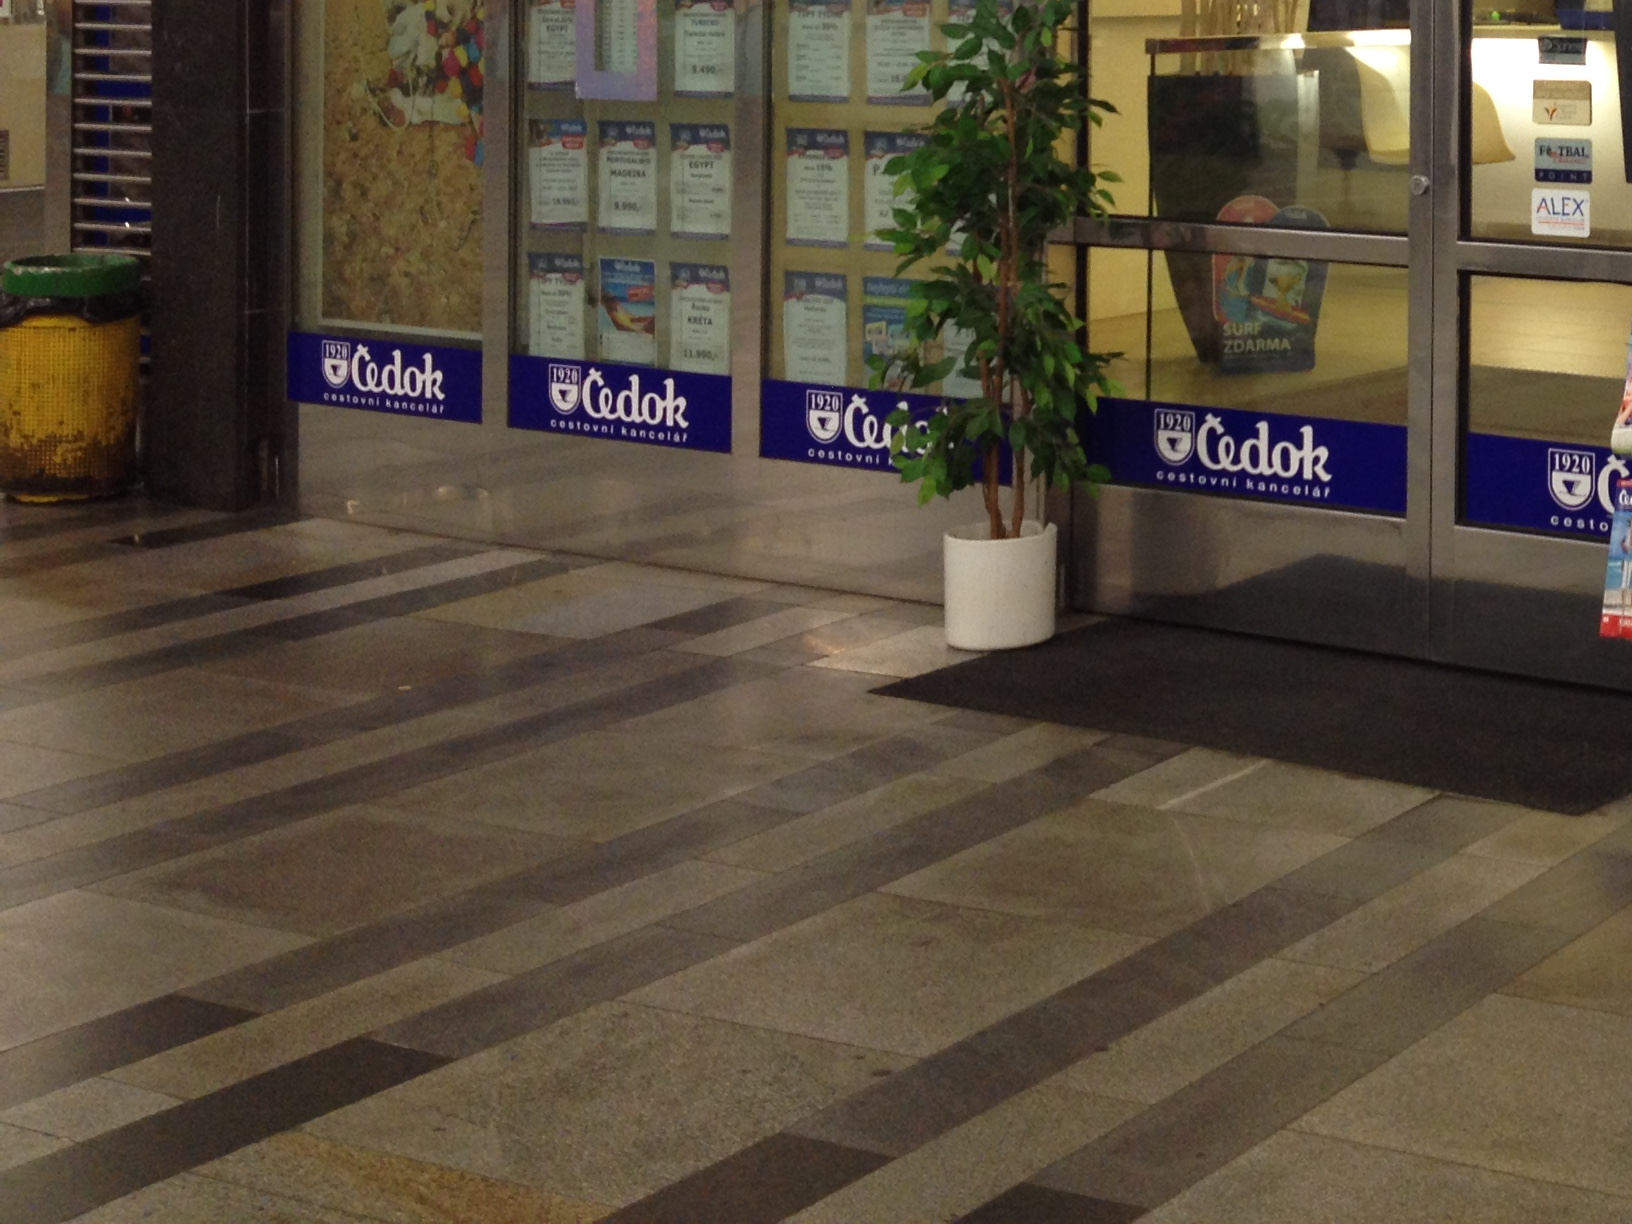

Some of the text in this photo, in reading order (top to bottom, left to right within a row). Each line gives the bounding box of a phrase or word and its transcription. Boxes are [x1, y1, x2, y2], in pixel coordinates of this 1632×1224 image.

[689, 161, 714, 169] EGYPT
[1536, 197, 1585, 217] ALEX
[1223, 323, 1262, 336] SURF
[1224, 338, 1292, 354] ZDARMA
[324, 343, 446, 401] 1920 Čedok
[323, 391, 446, 415] cestovní kancelář
[552, 366, 690, 429] 1920 Čedok
[810, 393, 840, 412] 1920
[550, 418, 688, 443] cestovní kancelář
[808, 447, 881, 465] cestovní
[1159, 413, 1332, 482] 1920 Čedok
[1553, 452, 1591, 474] 1920
[1156, 470, 1331, 499] cestovní kancelář
[1550, 515, 1609, 533] cesto
